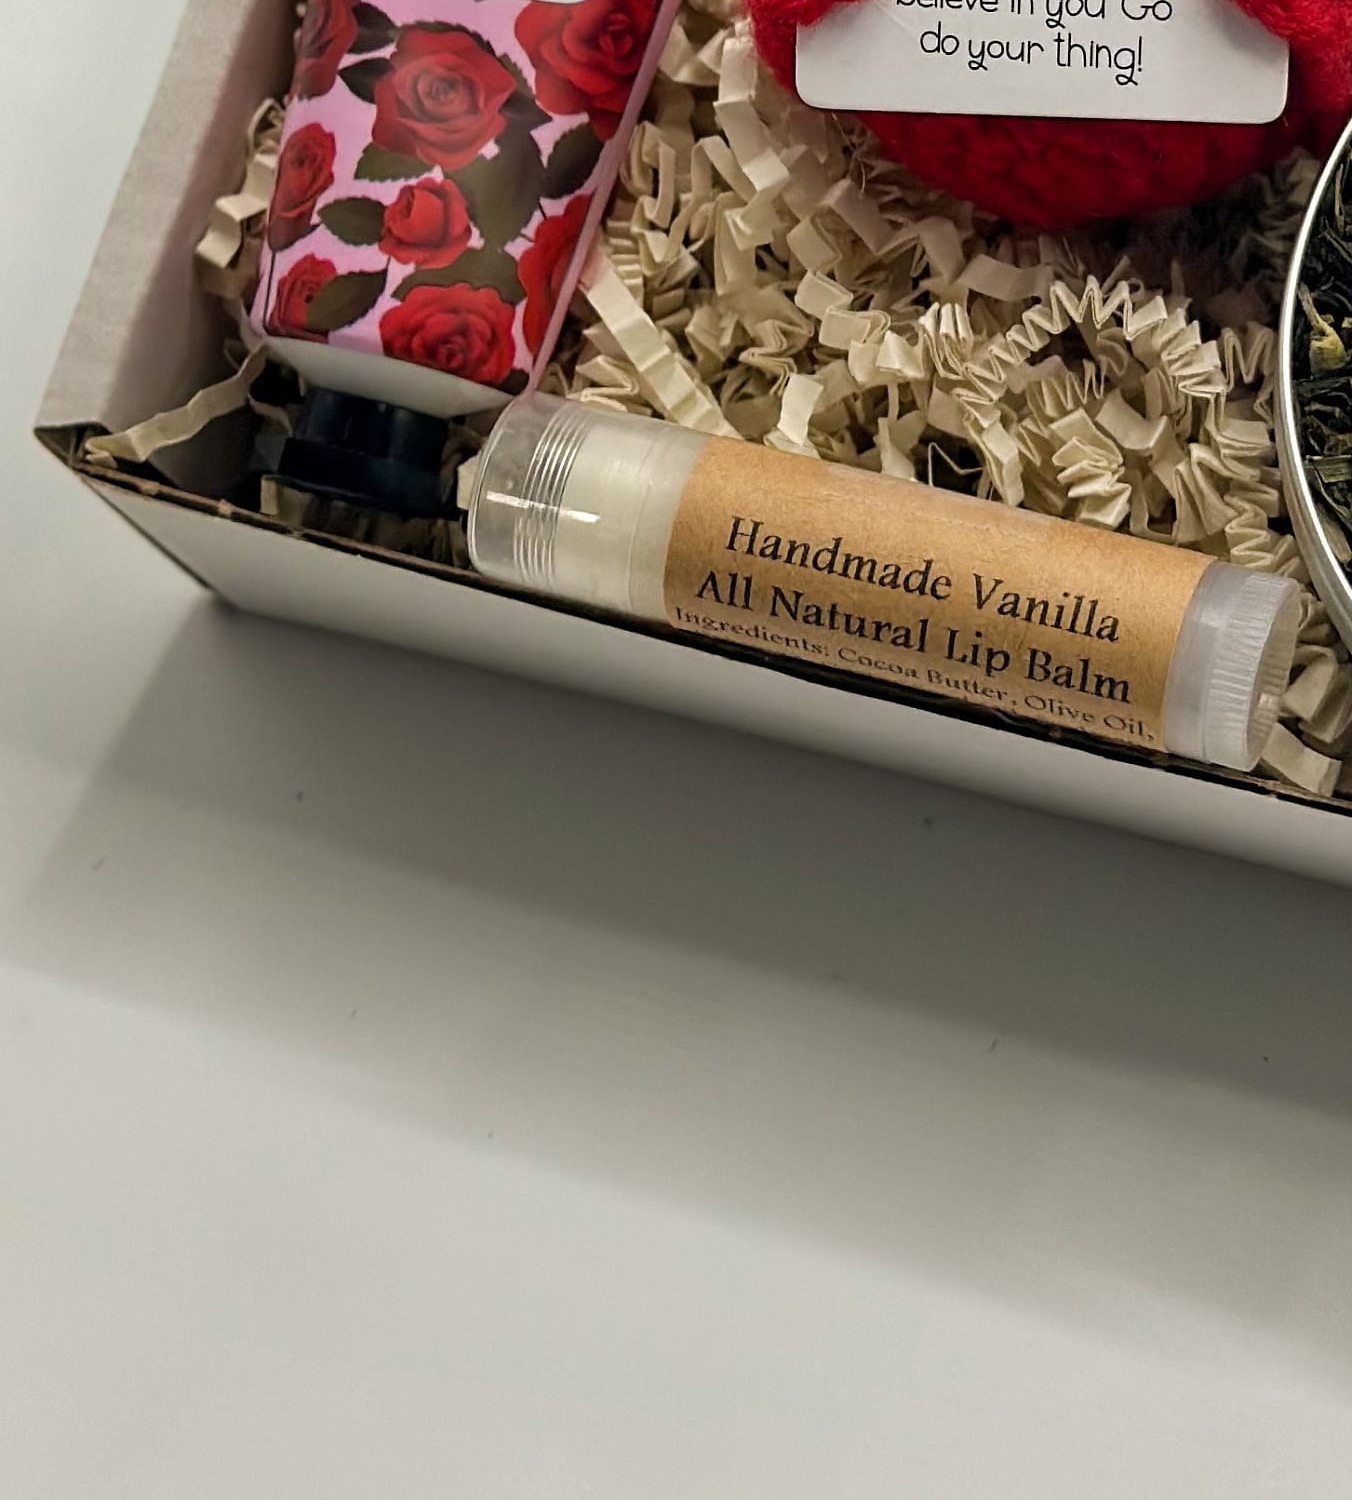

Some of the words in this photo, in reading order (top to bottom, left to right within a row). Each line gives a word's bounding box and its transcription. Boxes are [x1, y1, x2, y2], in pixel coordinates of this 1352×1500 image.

[919, 20, 961, 57] do
[967, 39, 1046, 71] your
[1052, 32, 1144, 86] thing!
[695, 570, 754, 612] All
[768, 584, 928, 654] Natural
[945, 628, 1012, 678] Lip
[1024, 647, 1132, 705] Balm
[724, 515, 952, 601] Handmade
[971, 572, 1121, 645] Vanilla
[675, 607, 830, 658] Ingredients:
[837, 647, 918, 679] Cocoa
[1024, 695, 1095, 724] Olive
